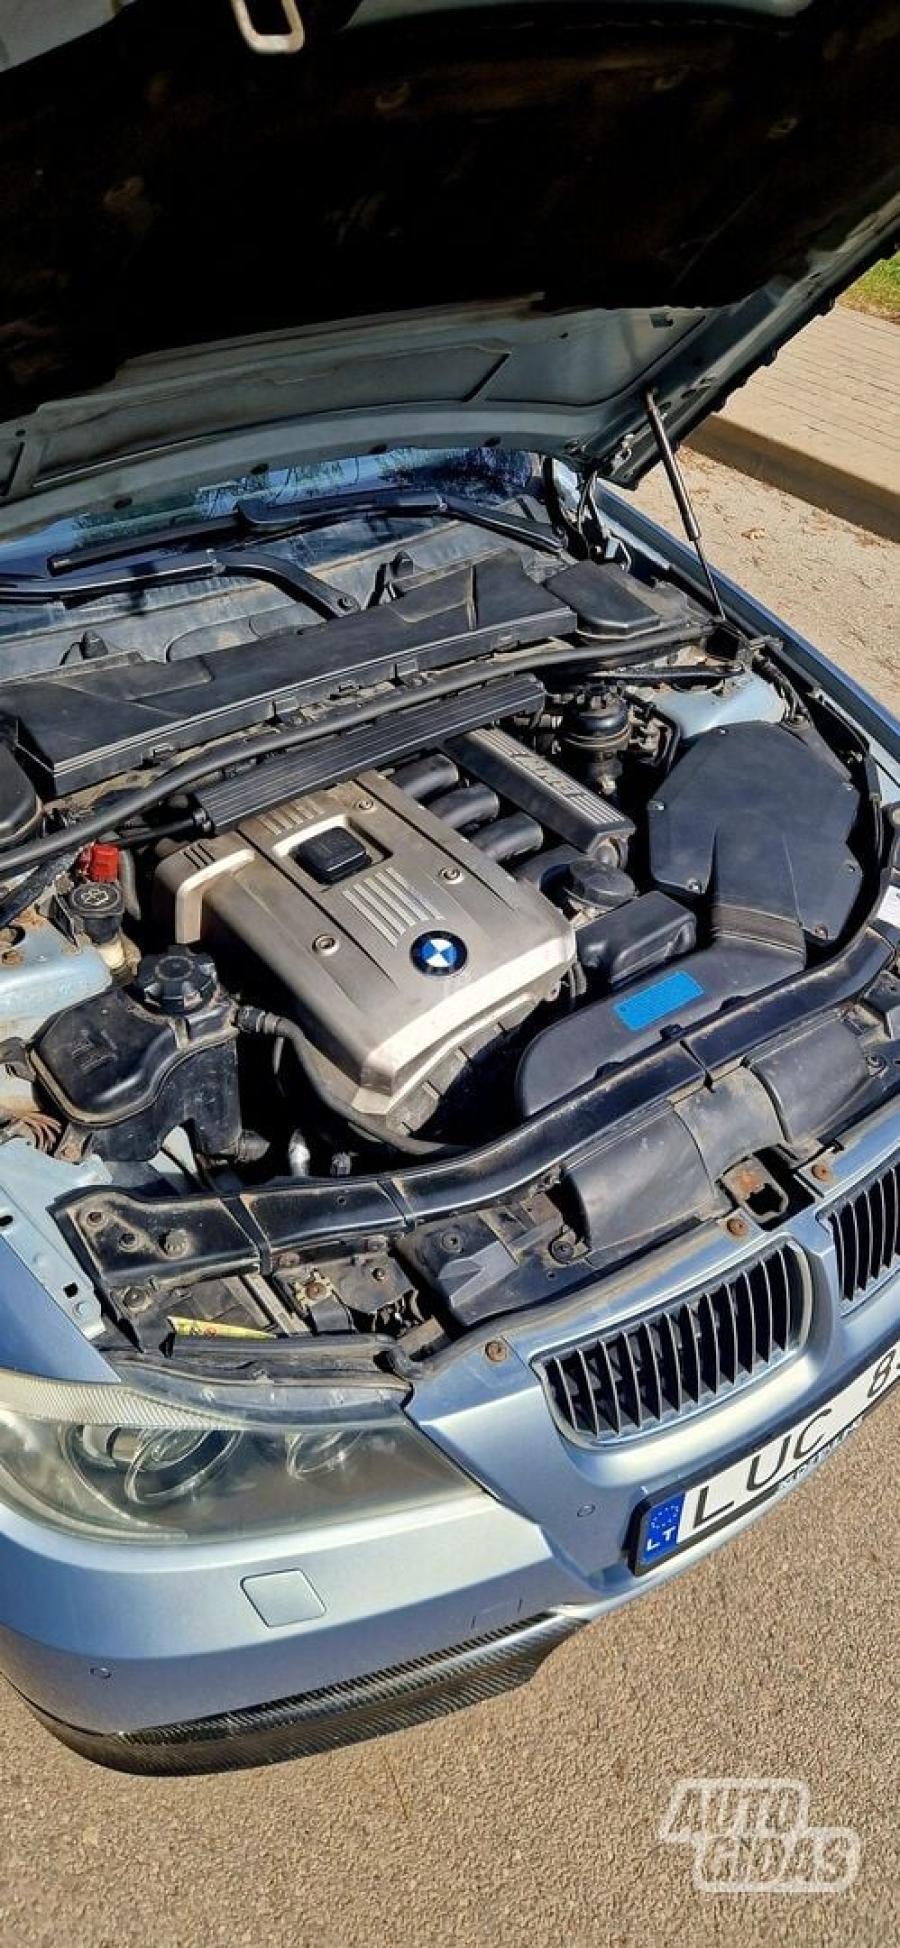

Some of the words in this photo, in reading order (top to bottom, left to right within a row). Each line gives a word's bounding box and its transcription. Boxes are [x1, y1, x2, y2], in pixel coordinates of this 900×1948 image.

[693, 1408, 831, 1528] LUC
[867, 1348, 900, 1398] 8
[647, 1526, 676, 1551] LT
